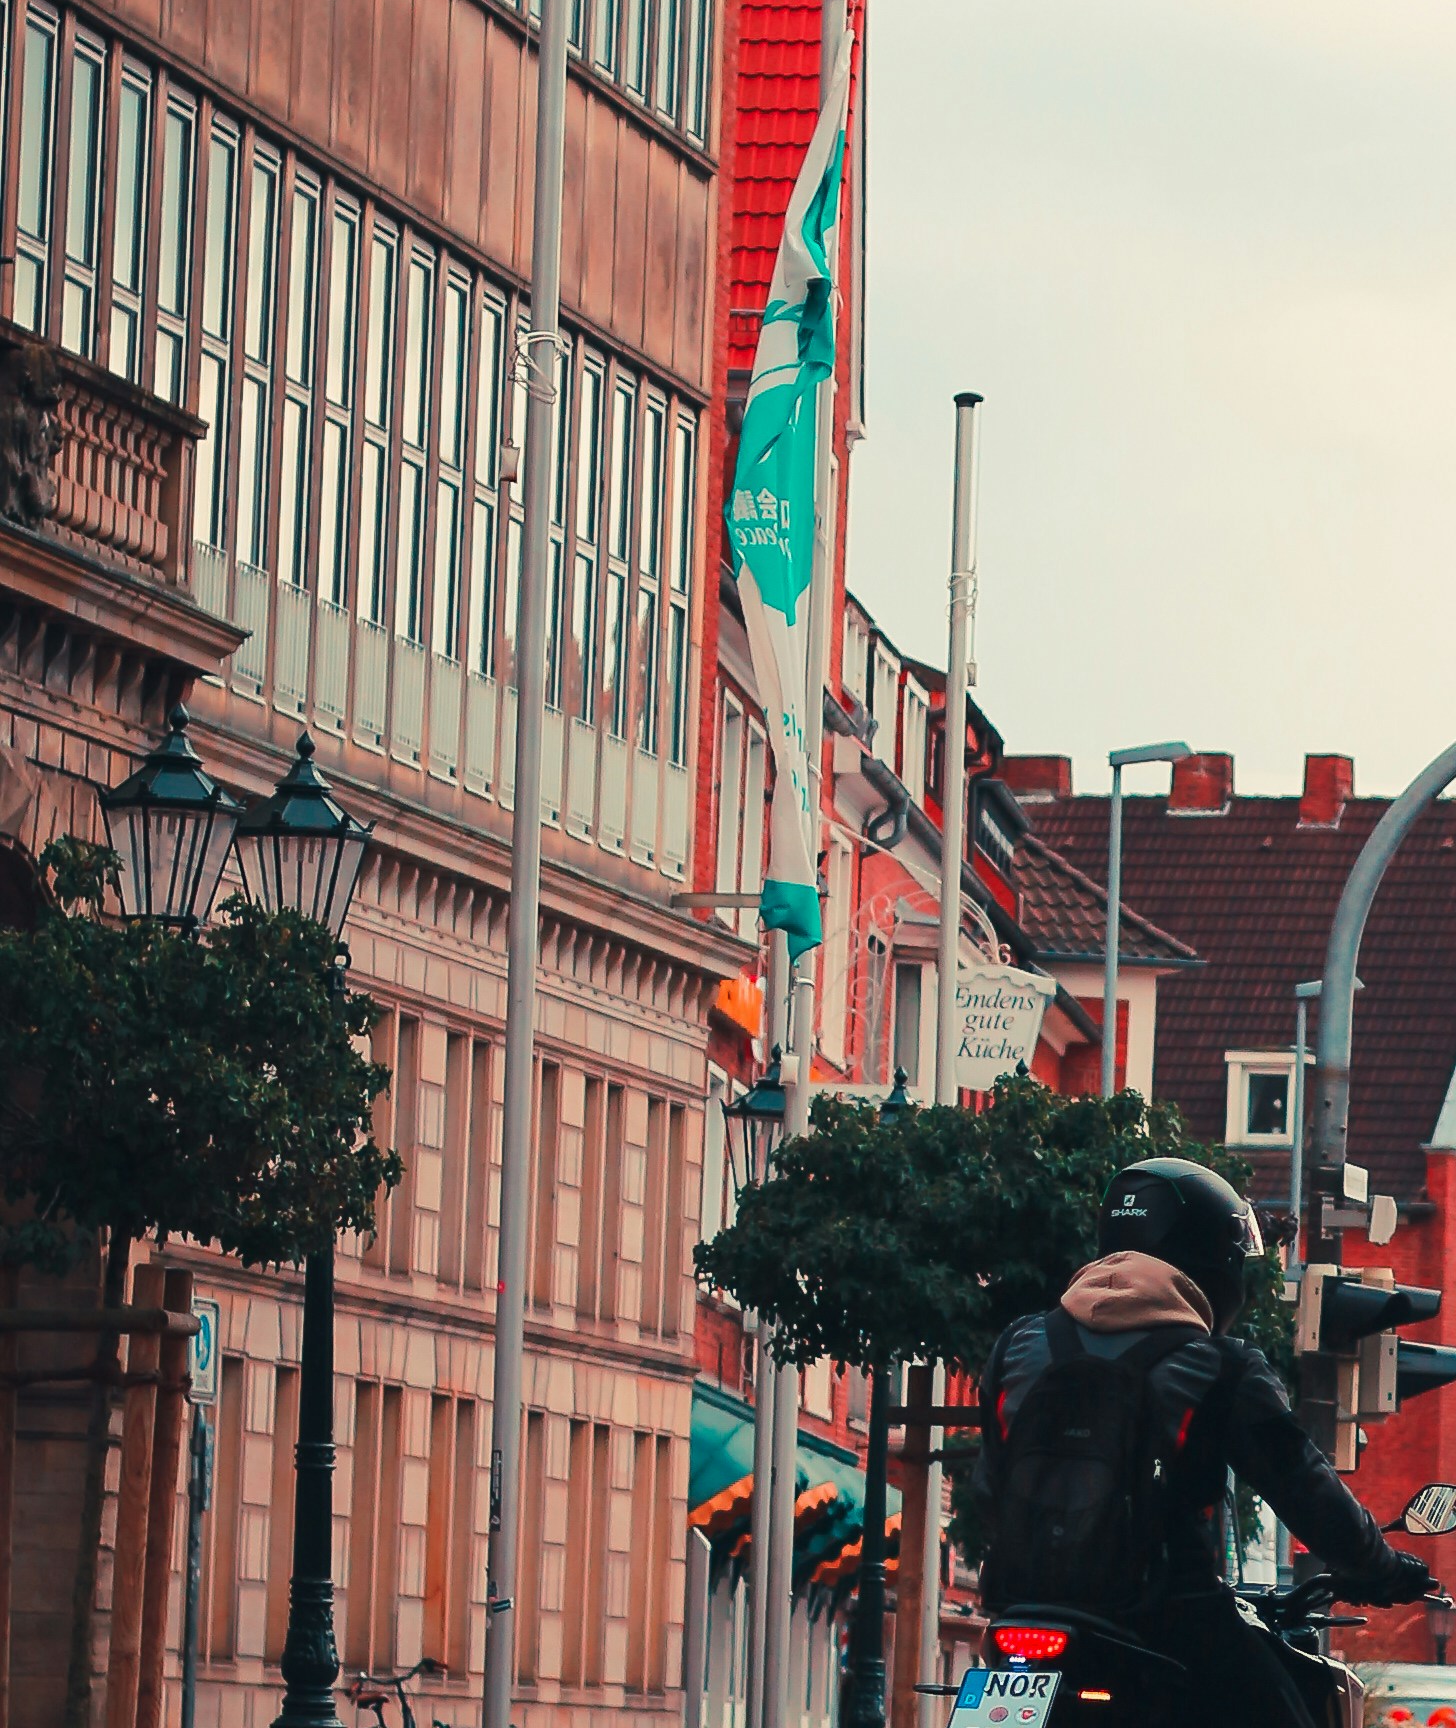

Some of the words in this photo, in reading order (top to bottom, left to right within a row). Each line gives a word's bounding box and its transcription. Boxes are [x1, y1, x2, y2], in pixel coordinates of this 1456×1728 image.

[956, 987, 1036, 1010] Emdens
[962, 1012, 1014, 1035] gute
[957, 1037, 1024, 1059] Küche
[1111, 1208, 1147, 1217] SHARK
[986, 1673, 1050, 1698] NOR
[965, 1694, 976, 1705] D
